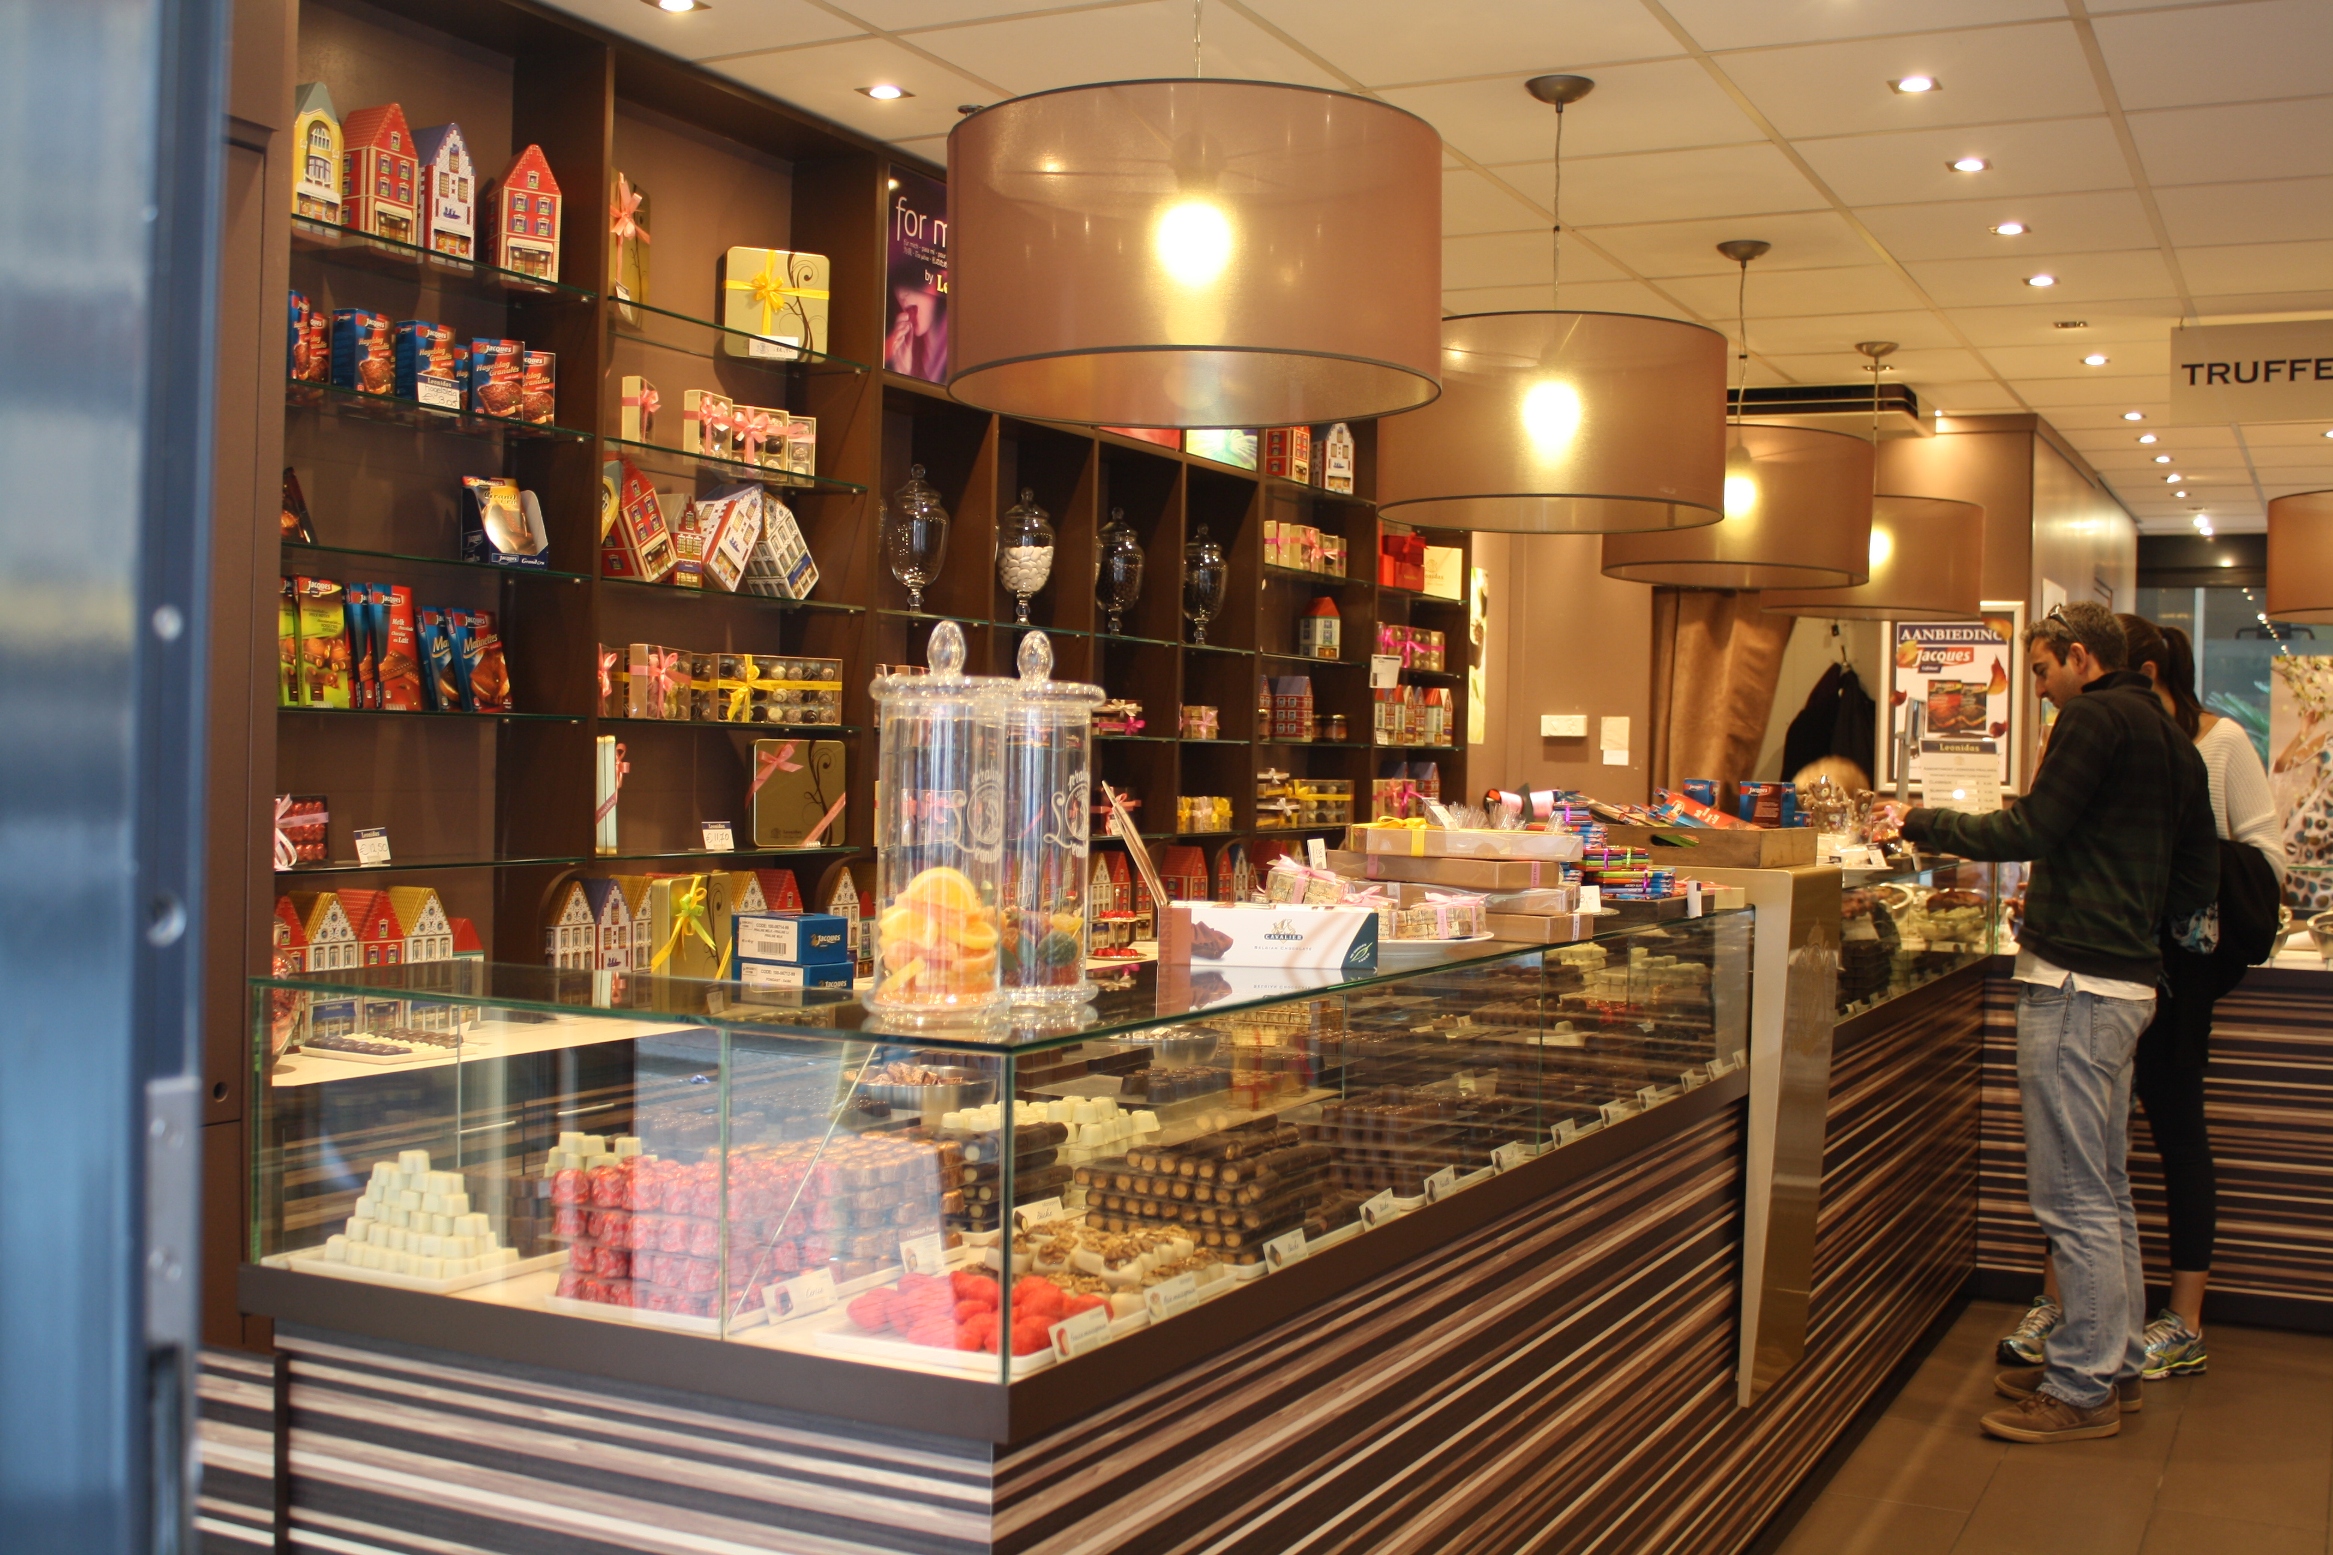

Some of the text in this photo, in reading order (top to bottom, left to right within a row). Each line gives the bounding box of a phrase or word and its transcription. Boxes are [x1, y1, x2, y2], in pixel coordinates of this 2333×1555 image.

[896, 196, 927, 241] for
[924, 269, 934, 285] by
[425, 328, 447, 339] Jacques
[483, 344, 512, 354] Jacques
[476, 361, 510, 372] Hagelslag
[489, 366, 520, 377] Granulés
[2181, 358, 2333, 386] TRUFFE
[427, 377, 452, 388] Leonidas
[308, 580, 331, 591] Jacques
[381, 593, 402, 604] Jacques
[392, 618, 405, 626] Melk
[465, 615, 486, 627] Jacques
[463, 633, 498, 654] Matinettes
[1911, 647, 1971, 668] Jacques
[1939, 742, 1980, 752] Leonidas
[1749, 787, 1768, 796] Jacques
[361, 831, 380, 839] Leonidas
[359, 843, 369, 856] €
[817, 934, 841, 947] Jacques
